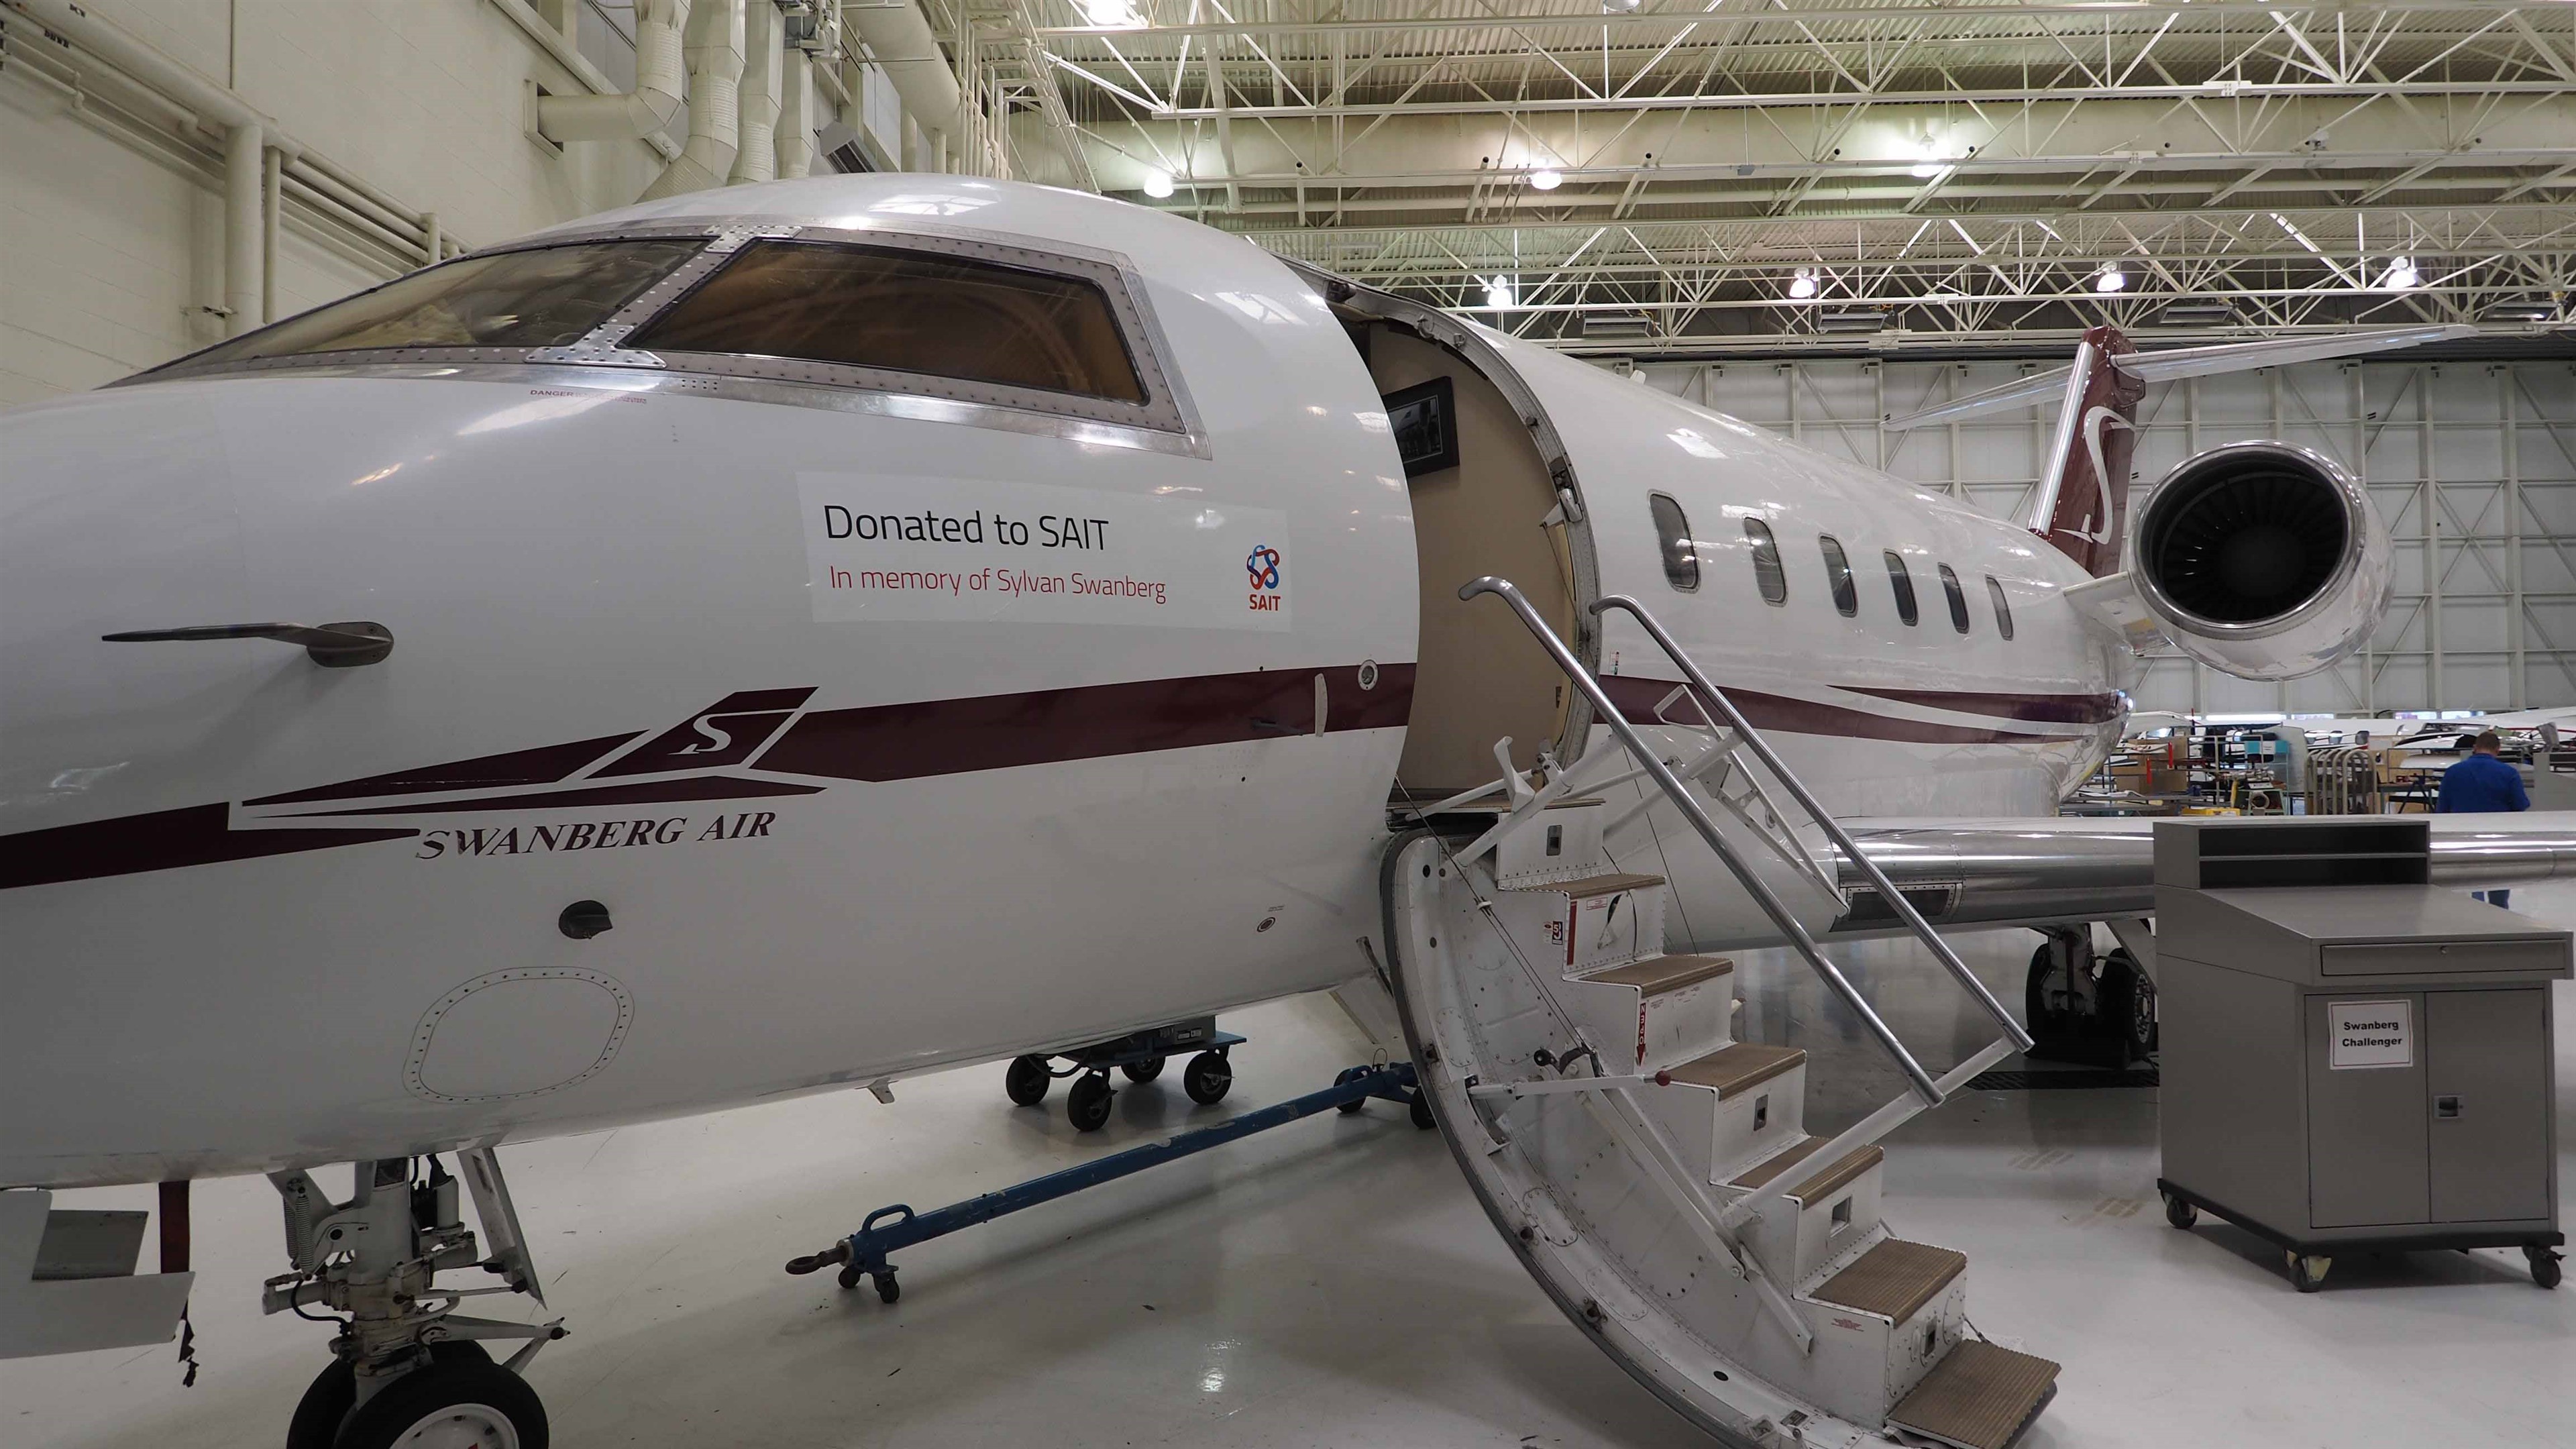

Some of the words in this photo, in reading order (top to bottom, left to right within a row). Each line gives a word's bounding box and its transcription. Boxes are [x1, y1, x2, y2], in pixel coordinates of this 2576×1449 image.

[529, 389, 574, 397] DANGER
[824, 504, 984, 544] Donated
[994, 514, 1029, 546] to
[1038, 516, 1110, 551] SAIT
[830, 565, 853, 590] In
[861, 572, 961, 597] memory
[969, 568, 991, 591] of
[997, 569, 1065, 598] Sylvan
[1071, 572, 1167, 604] Swanberg
[1248, 594, 1281, 612] SAIT
[415, 817, 688, 860] SWANBERG
[695, 812, 777, 843] AIR
[2343, 1021, 2399, 1031] Swanberg
[2342, 1038, 2402, 1047] Challenger
